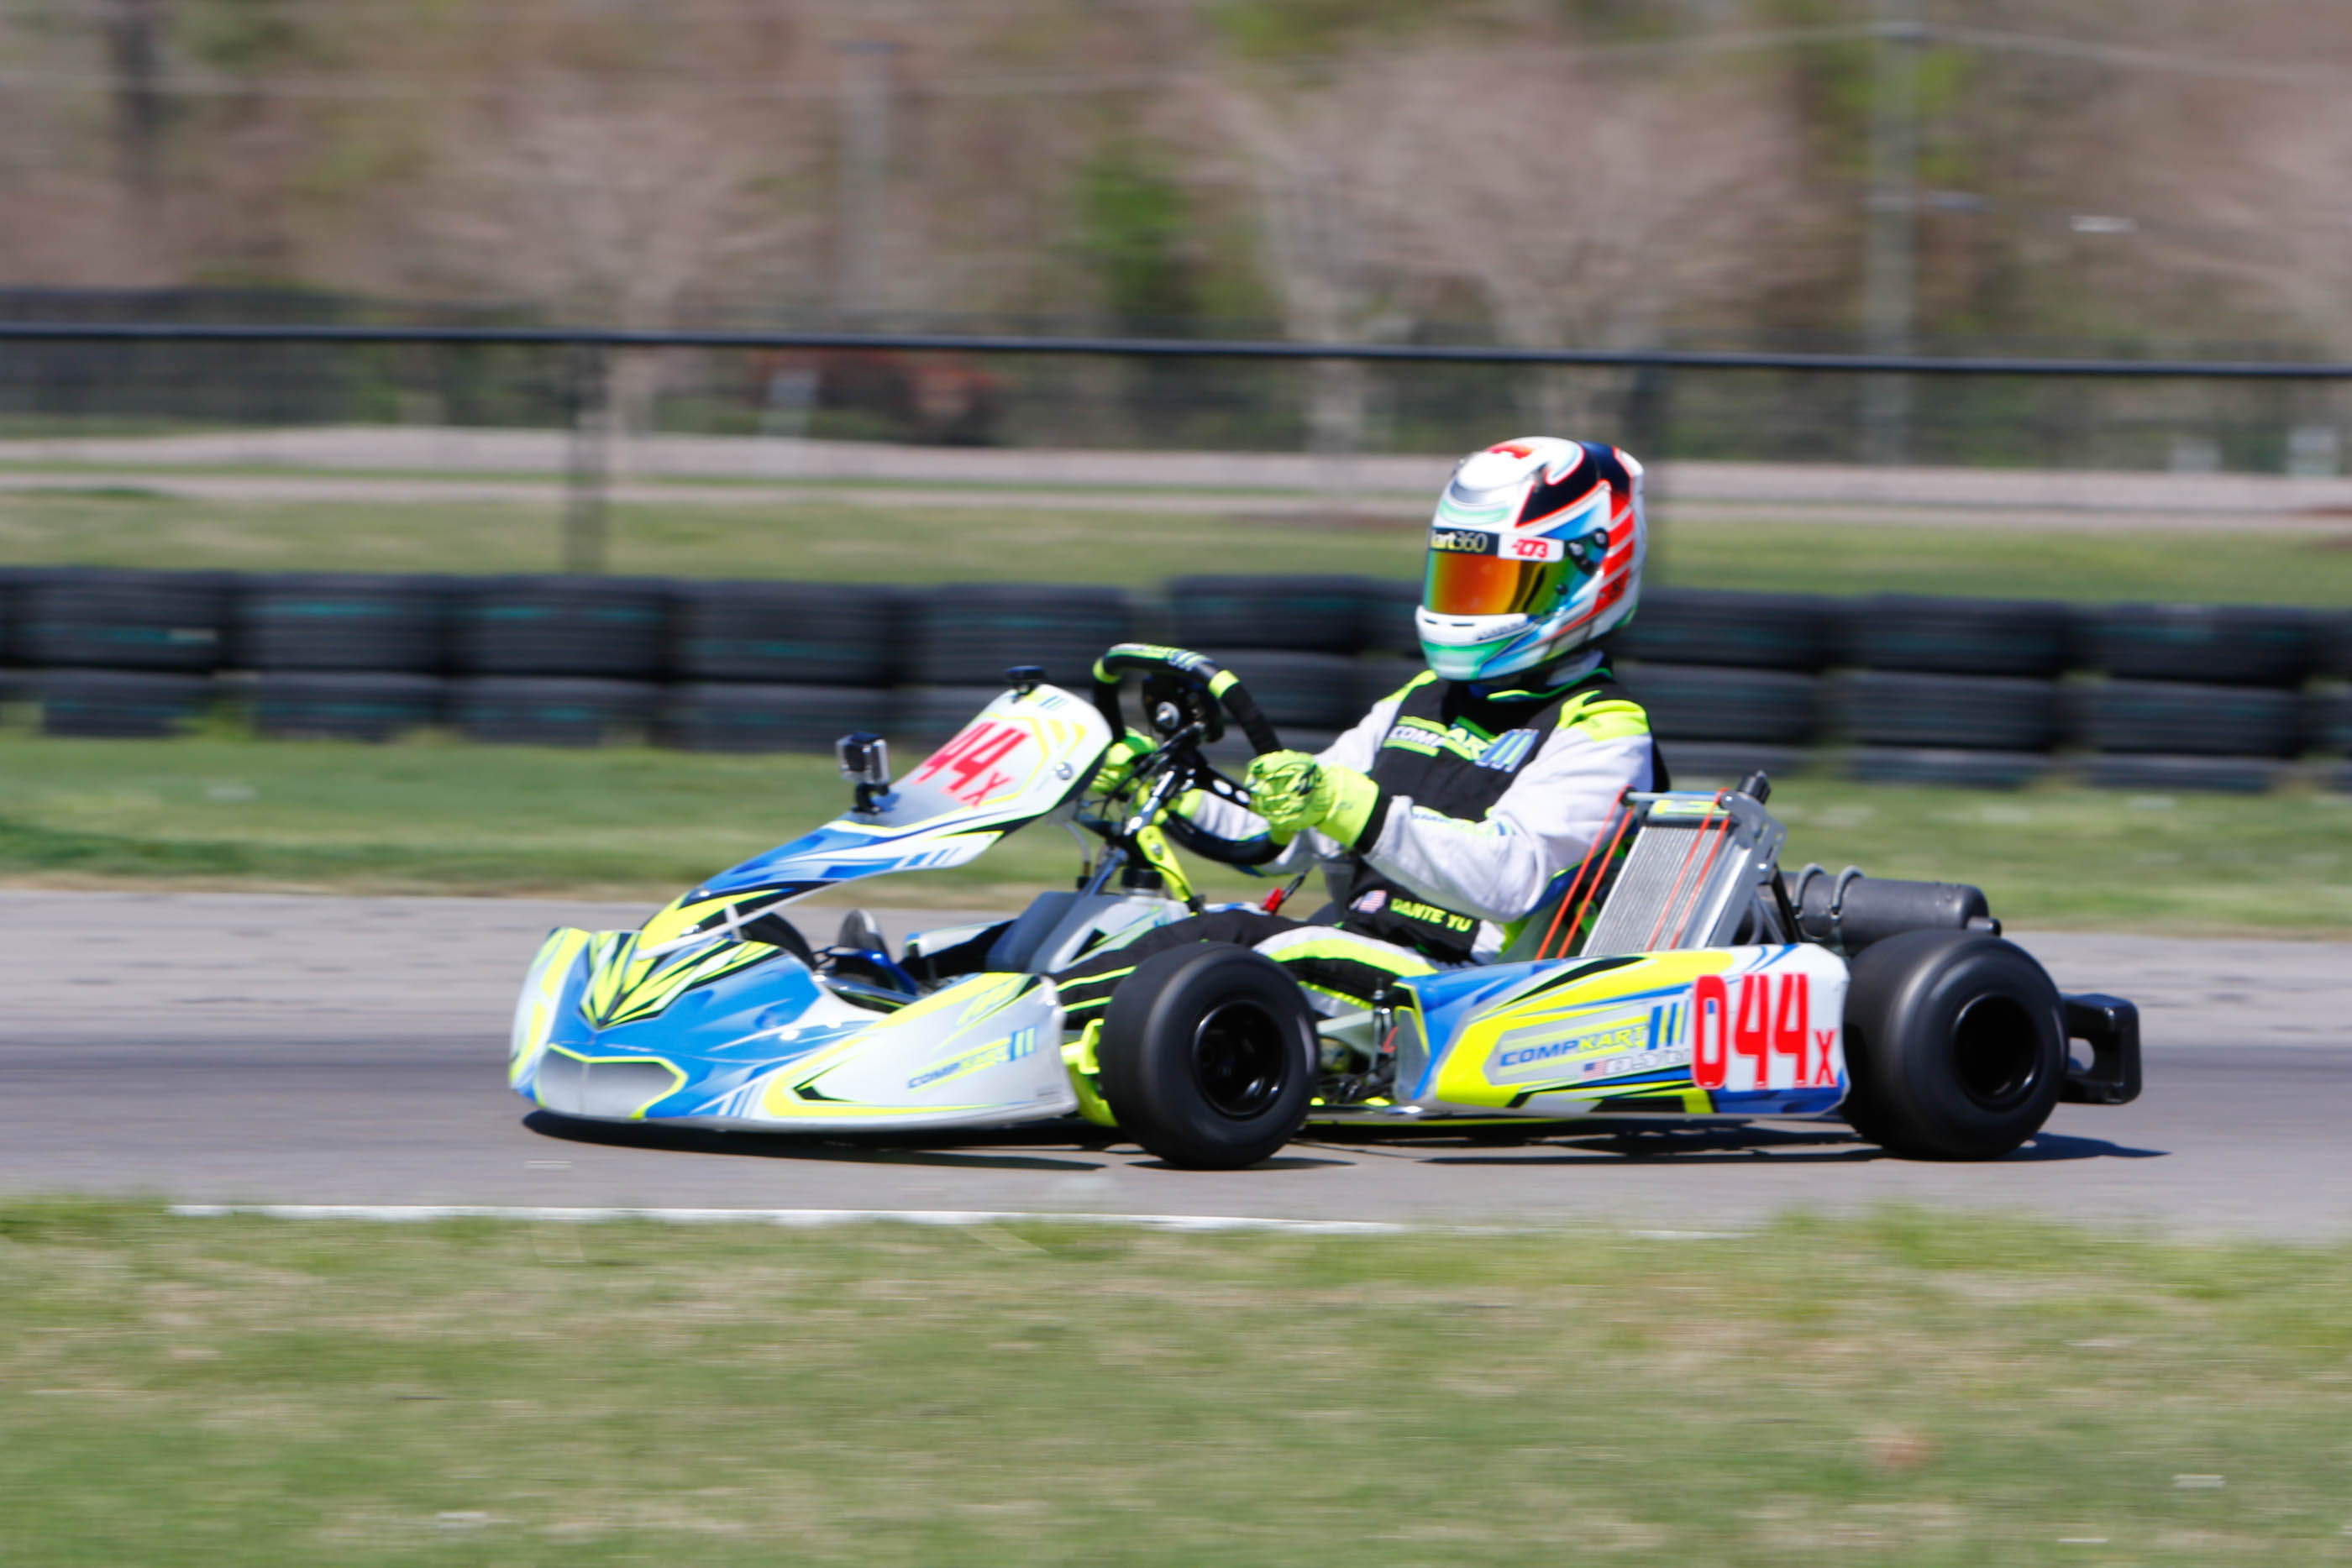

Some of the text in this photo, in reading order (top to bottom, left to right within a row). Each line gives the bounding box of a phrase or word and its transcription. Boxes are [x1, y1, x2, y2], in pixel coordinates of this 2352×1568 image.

[1390, 898, 1473, 932] DANTE YU
[1499, 1025, 1647, 1067] COMPKART
